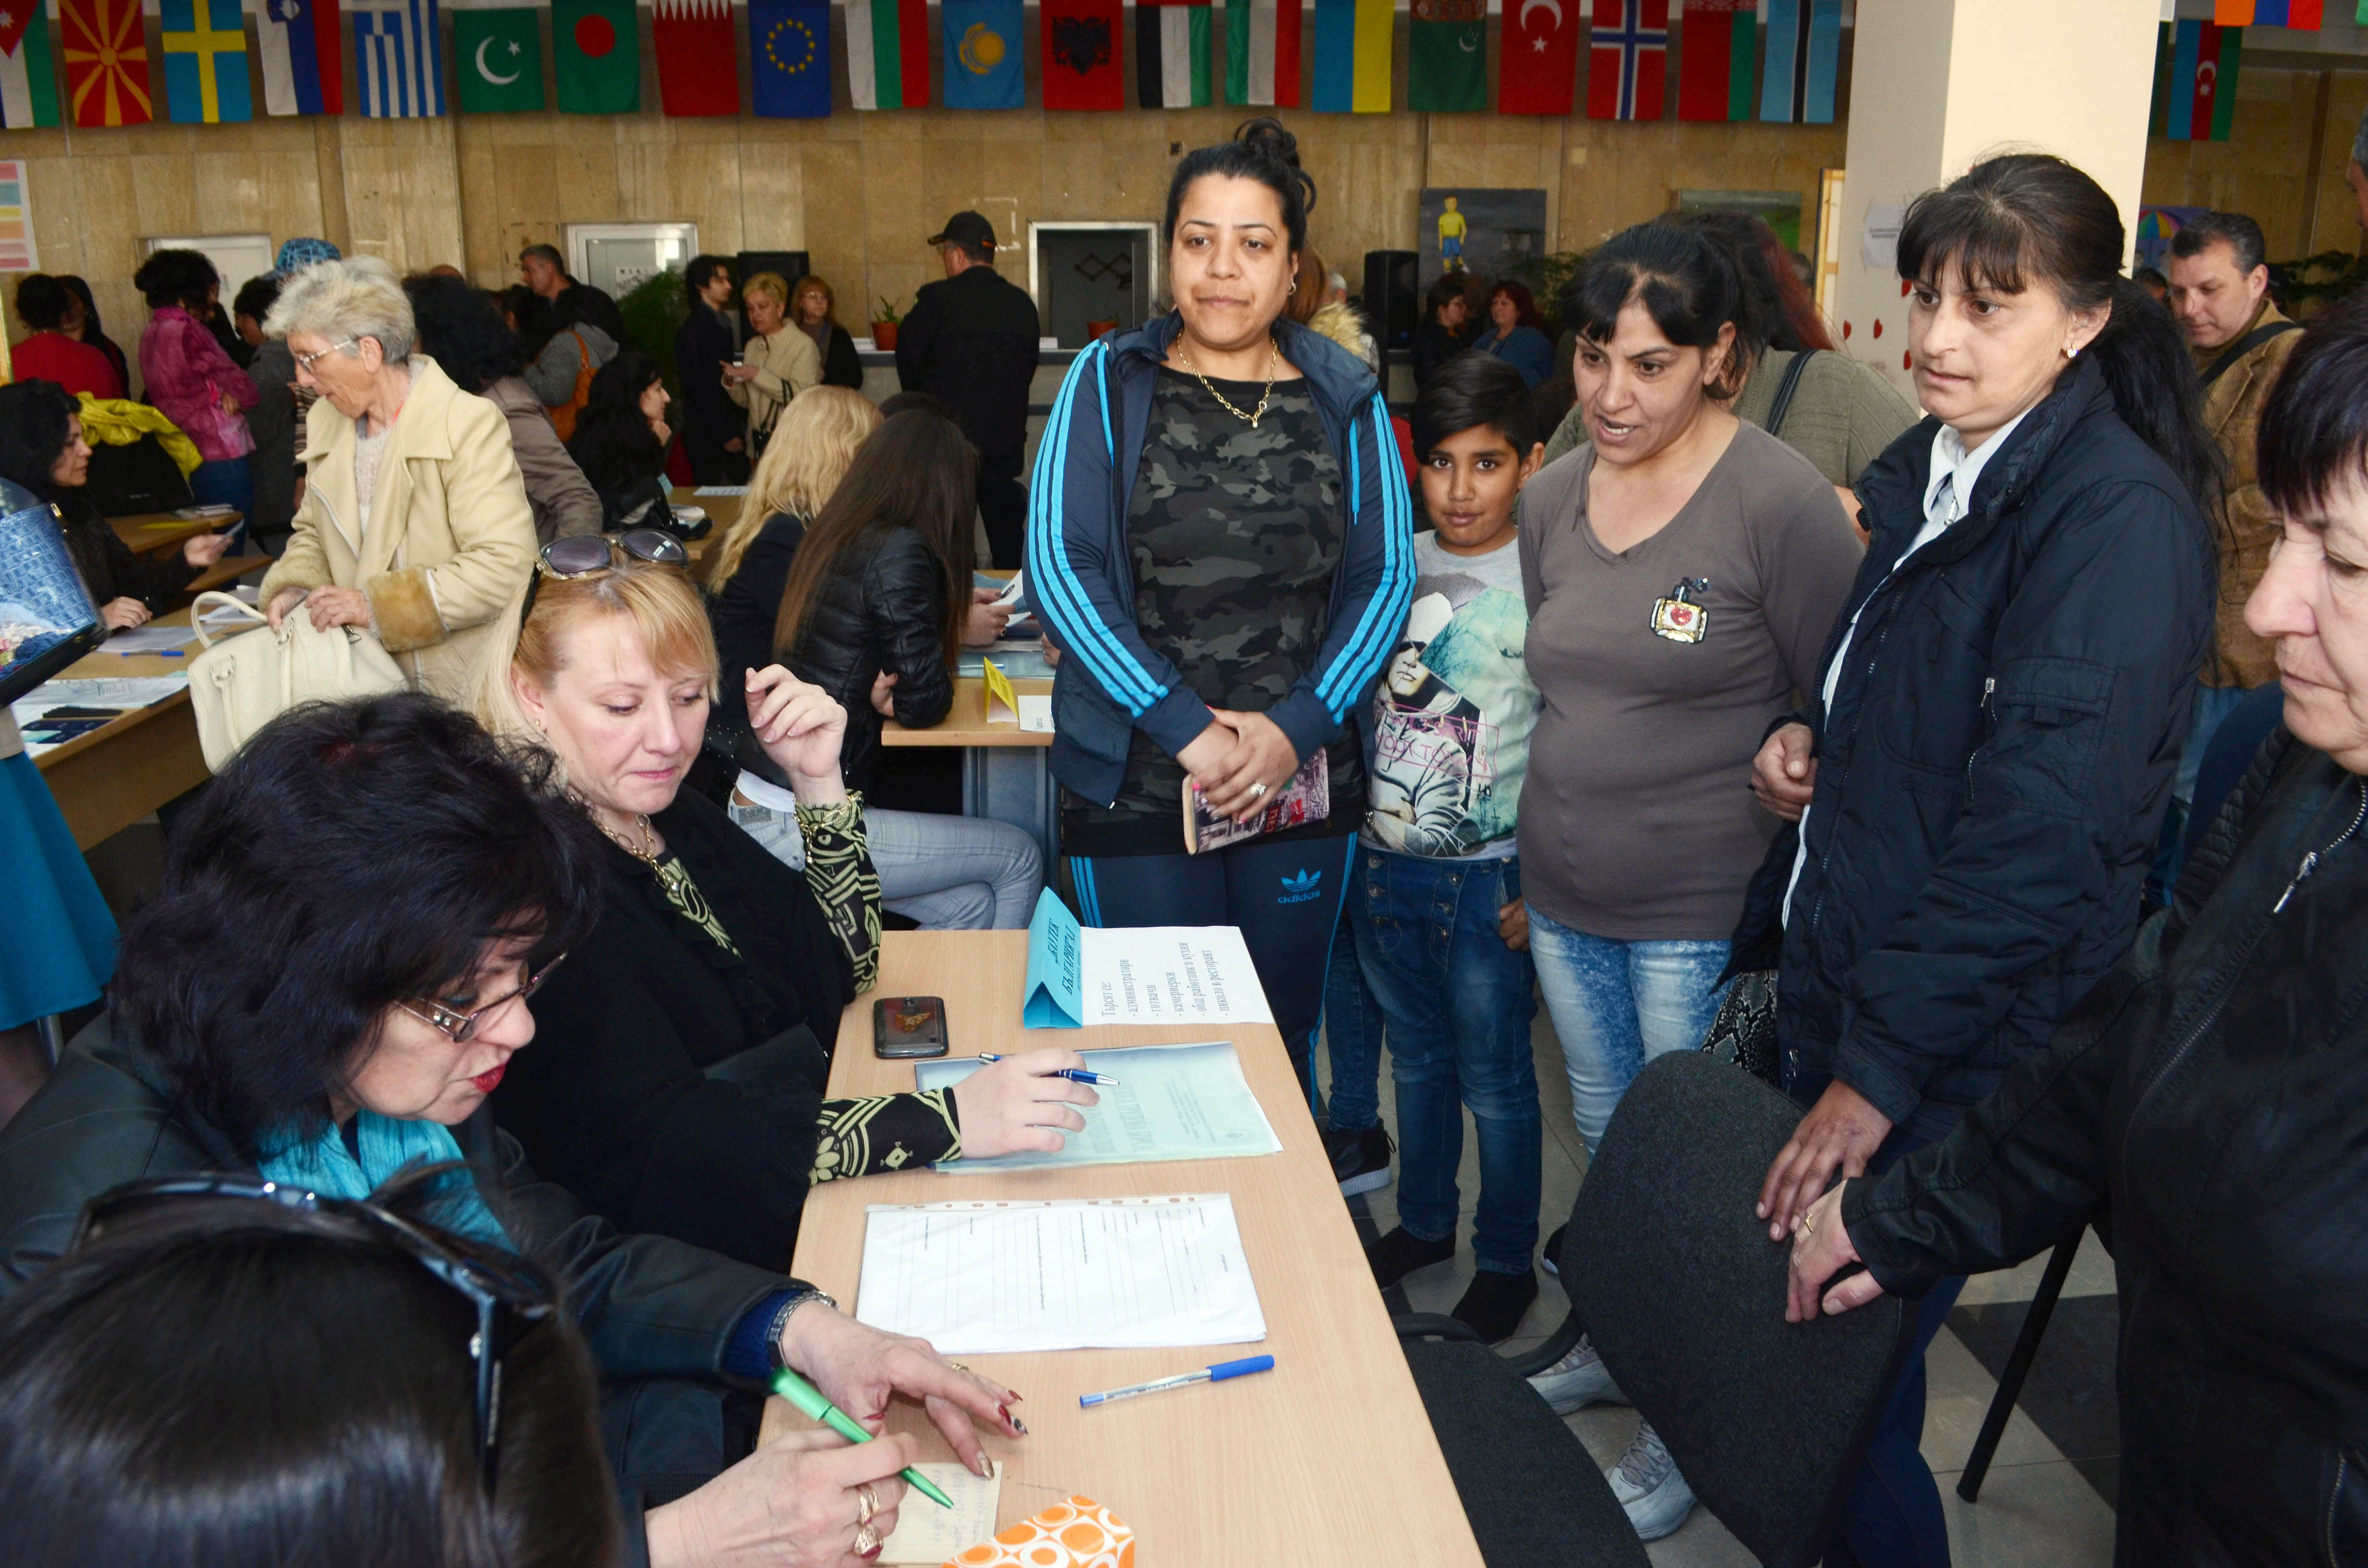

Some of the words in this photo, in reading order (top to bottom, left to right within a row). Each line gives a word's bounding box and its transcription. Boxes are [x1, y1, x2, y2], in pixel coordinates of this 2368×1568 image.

[1434, 722, 1481, 744] SRIT
[1278, 890, 1320, 904] adidas
[1179, 942, 1196, 960] кухня
[1202, 949, 1224, 980] ресторант
[1101, 981, 1111, 991] се:
[1119, 959, 1138, 1012] администратори
[1166, 972, 1184, 1012] камериерки
[1186, 966, 1207, 996] работник
[1102, 992, 1119, 1016] Търсят
[1146, 984, 1161, 1012] готвачи
[1213, 987, 1230, 1011] пиколо
